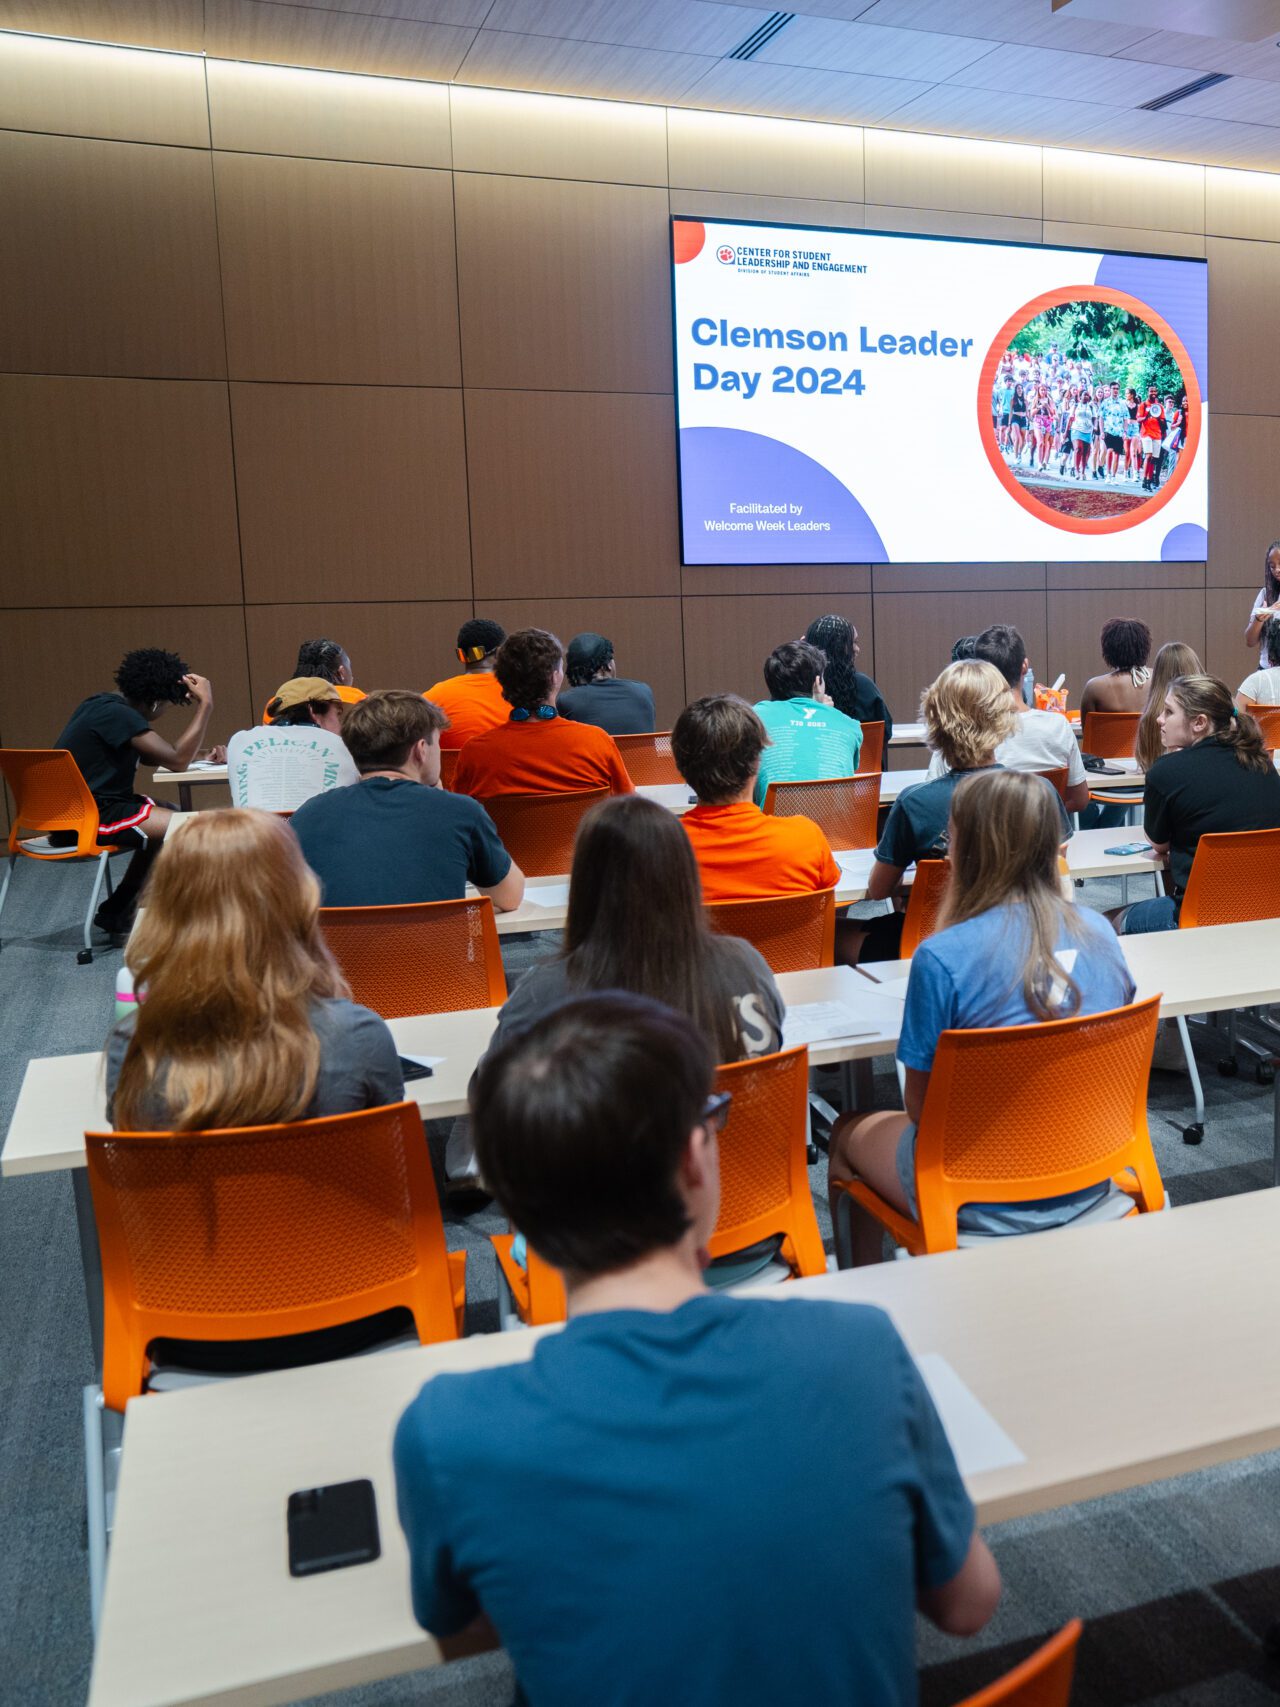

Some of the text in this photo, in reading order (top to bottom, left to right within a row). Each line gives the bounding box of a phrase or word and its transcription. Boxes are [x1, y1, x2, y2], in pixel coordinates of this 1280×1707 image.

[737, 246, 831, 262] CENTER FOR STUDENT
[737, 257, 868, 274] LEADERSHIP AND ENGAGEMENT
[691, 317, 973, 358] Clemson Leader
[693, 363, 866, 399] Day 2024
[729, 503, 803, 516] Facilitated by
[704, 520, 831, 531] Welcome Week Leaders
[236, 763, 248, 809] AYING
[242, 737, 335, 758] PELICAN
[321, 761, 340, 793] MIS
